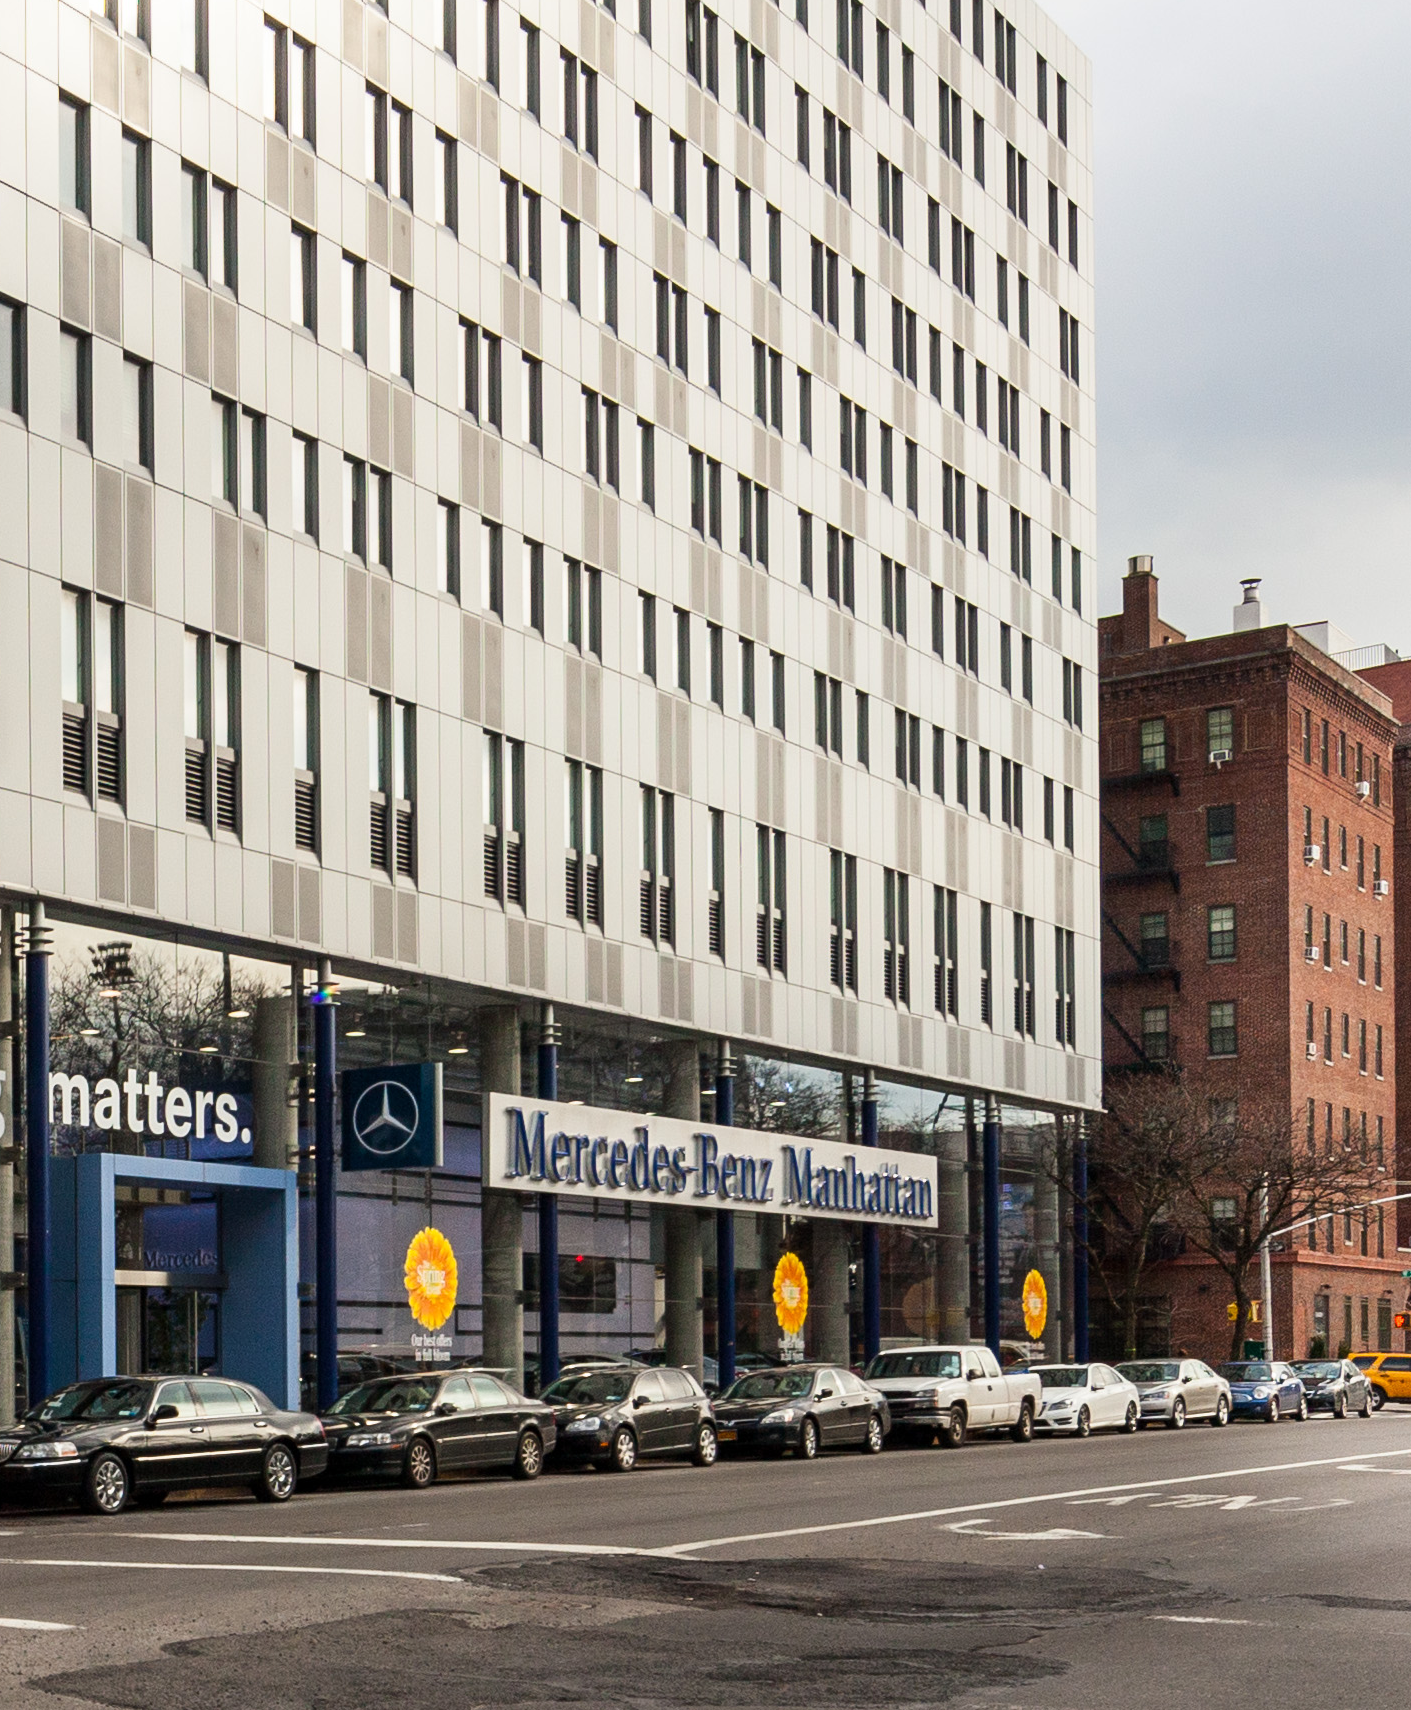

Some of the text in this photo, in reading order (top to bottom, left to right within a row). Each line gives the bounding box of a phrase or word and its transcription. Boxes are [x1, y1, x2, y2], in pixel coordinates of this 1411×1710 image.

[48, 1068, 252, 1144] matters.
[505, 1107, 933, 1219] Mercedes-Benz Manhattan
[144, 1248, 218, 1268] Mercedes
